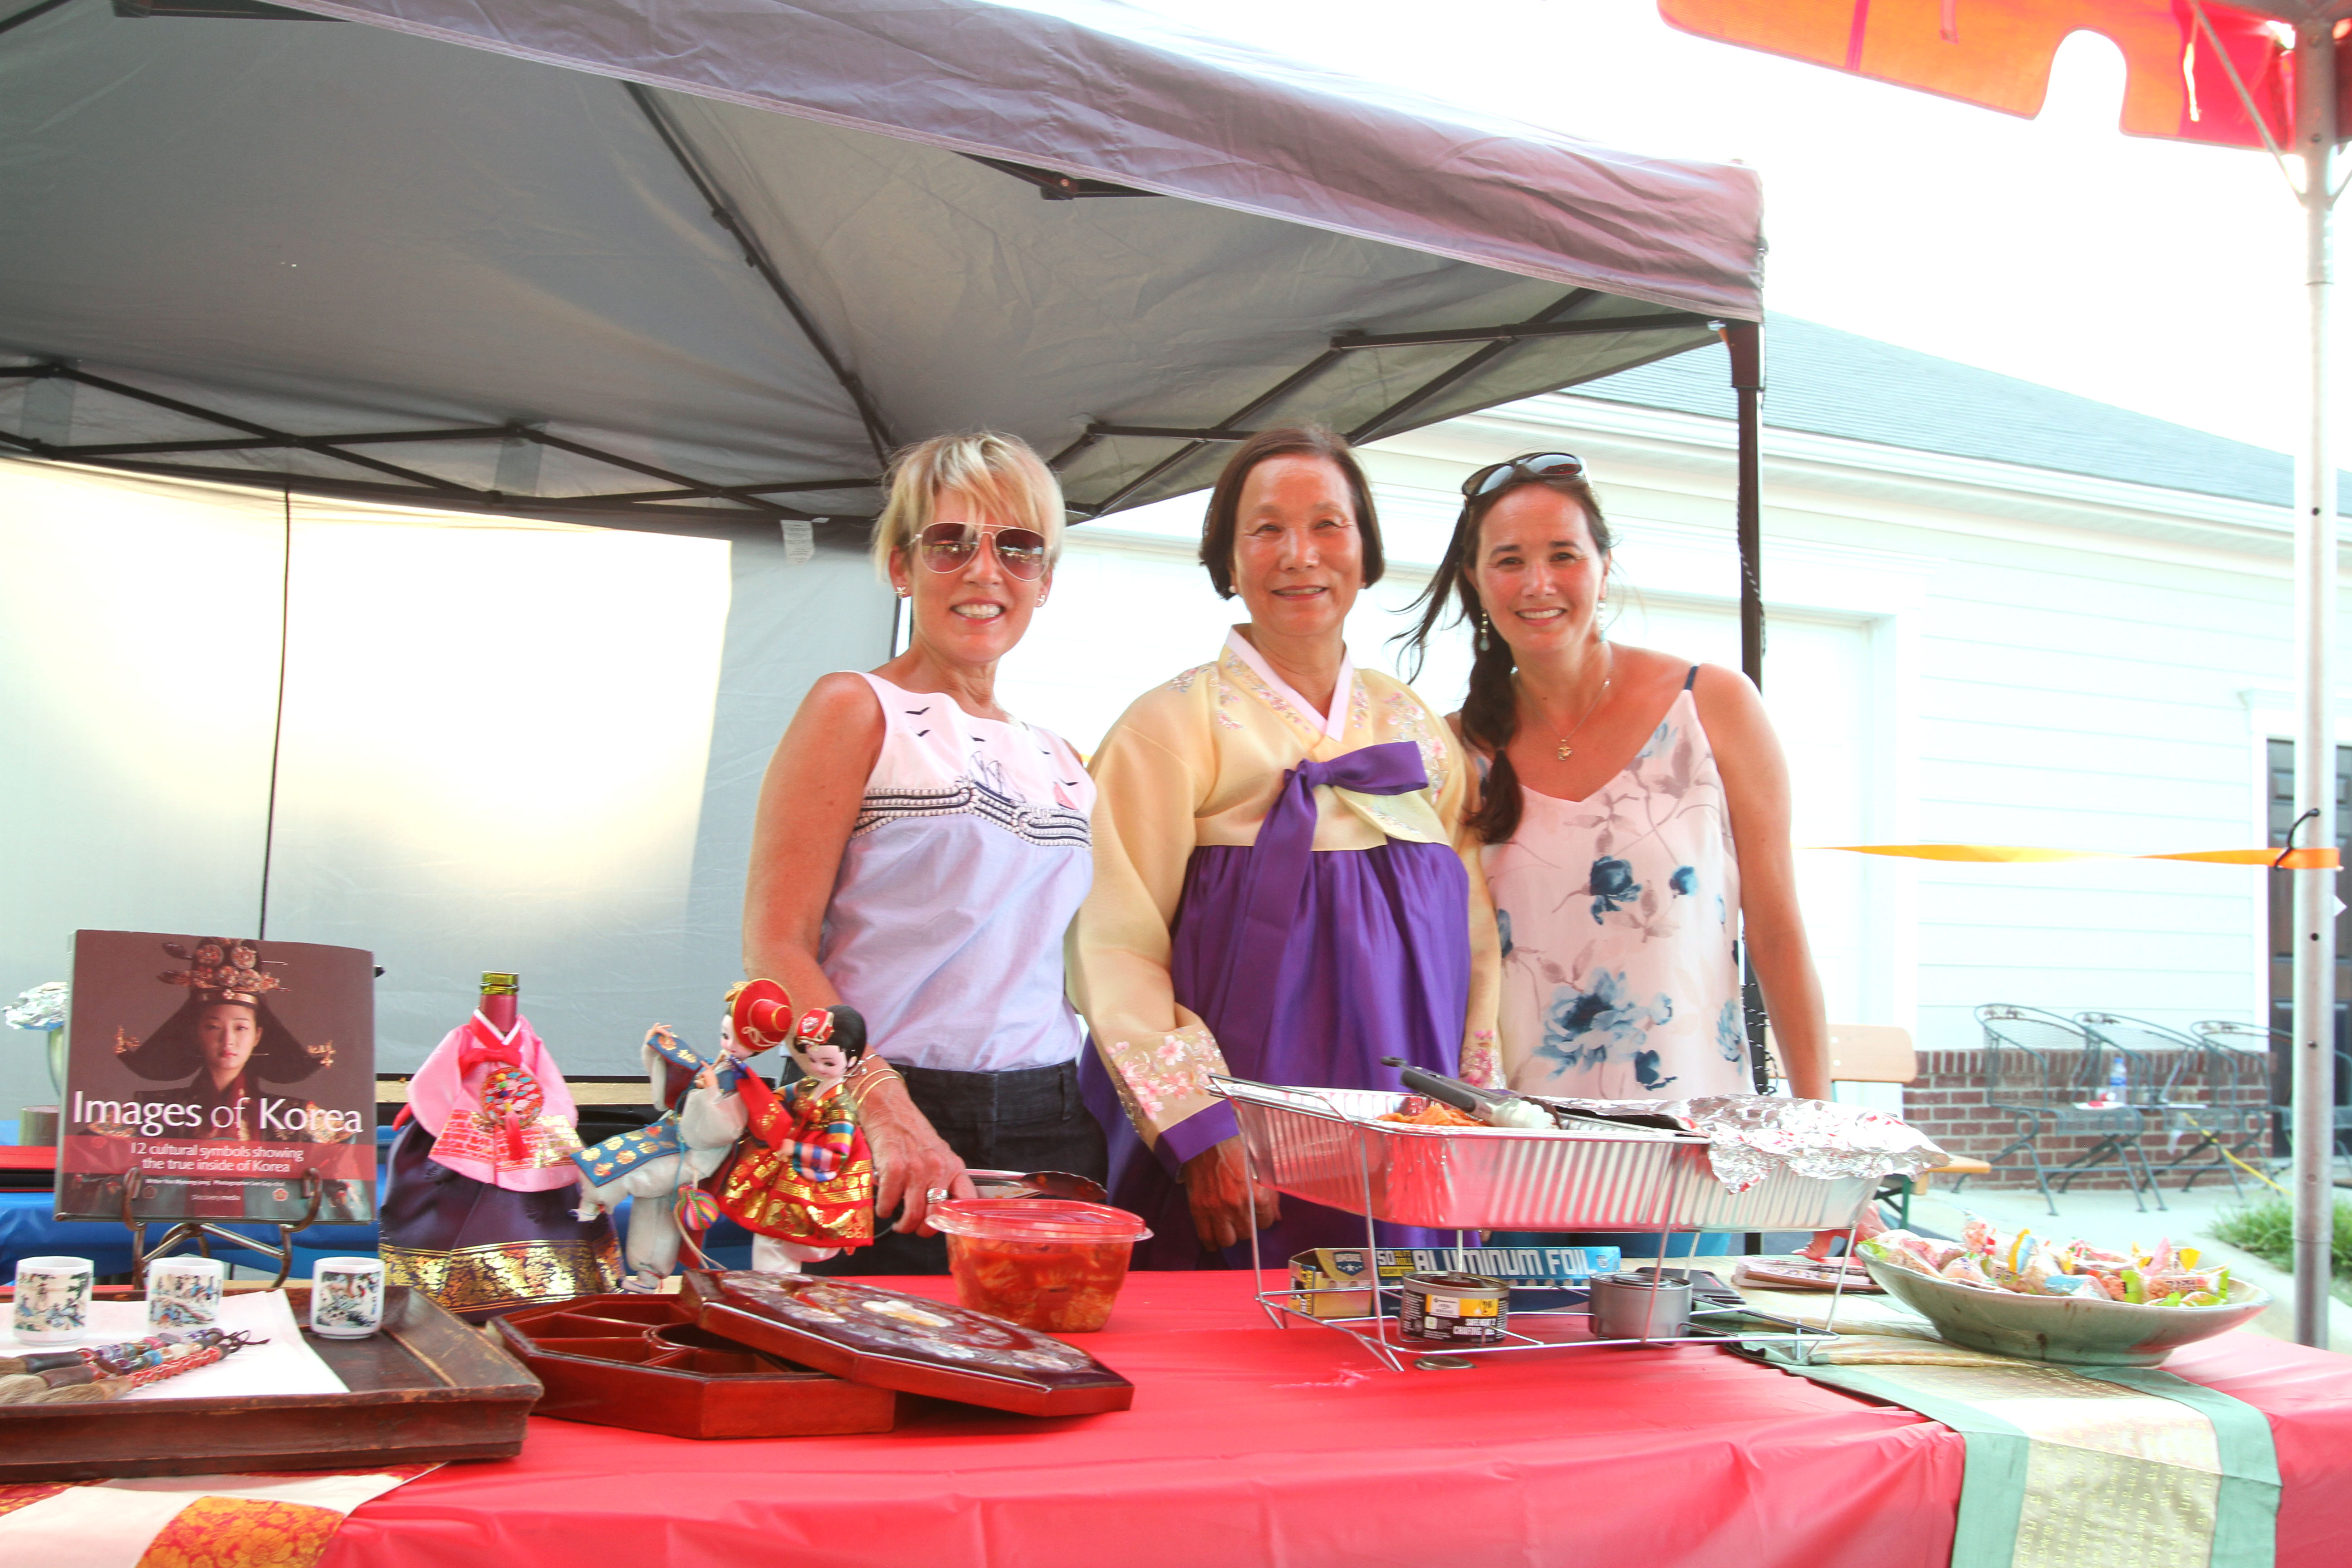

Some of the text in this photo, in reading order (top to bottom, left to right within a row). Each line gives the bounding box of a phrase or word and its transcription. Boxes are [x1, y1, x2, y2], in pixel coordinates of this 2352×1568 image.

[74, 1090, 364, 1136] Images of Korea
[131, 1142, 304, 1162] 12 cultural symbols showing
[142, 1158, 290, 1173] the true inside of Korea
[1377, 1250, 1396, 1265] 50
[1545, 1249, 1597, 1275] FOIL
